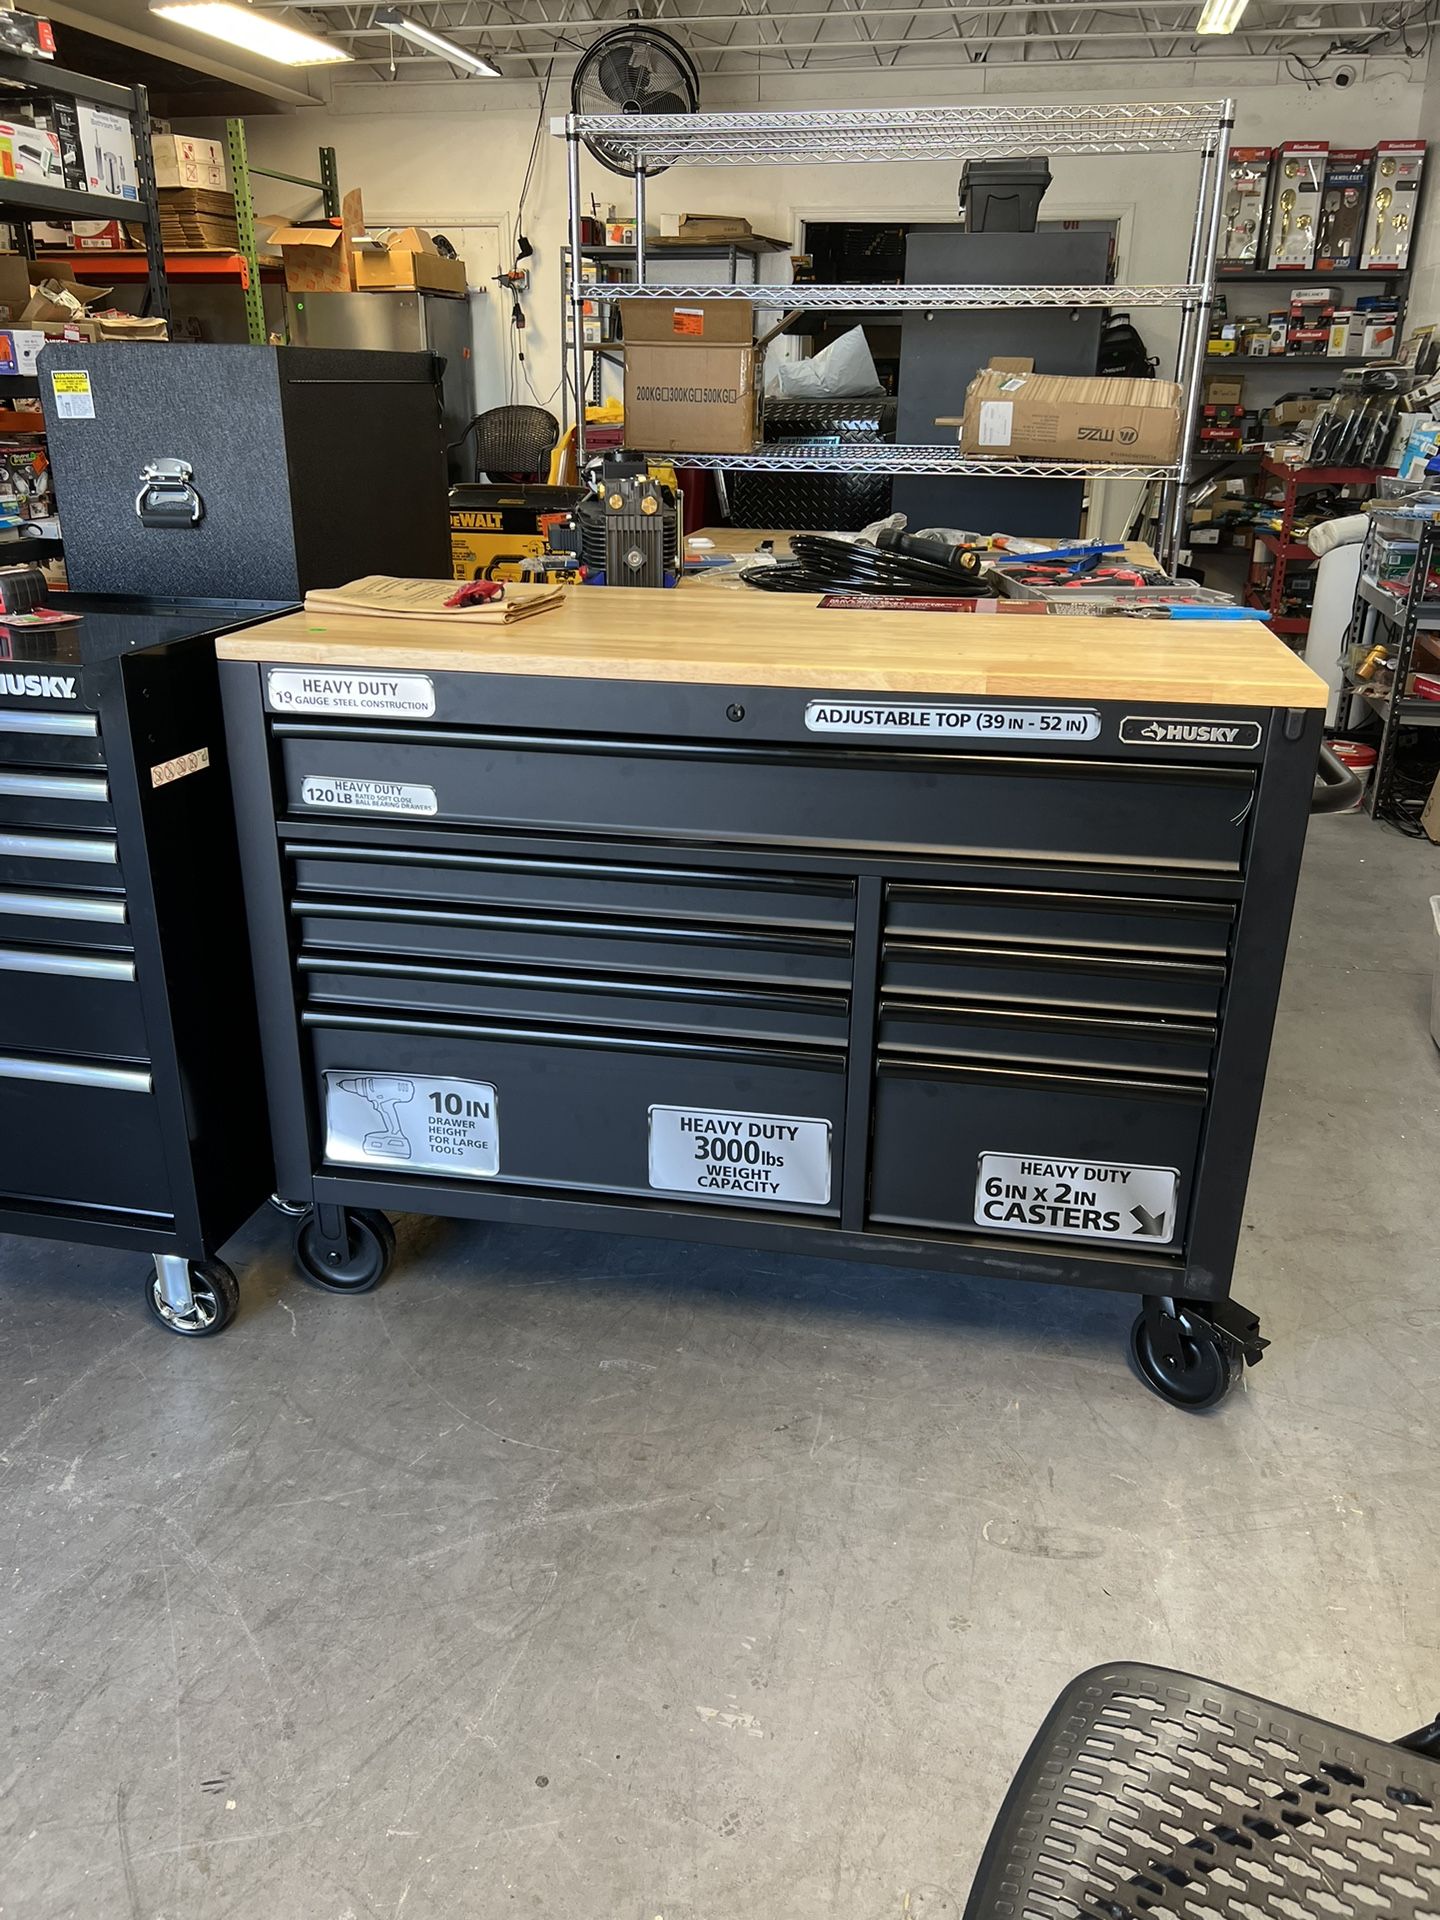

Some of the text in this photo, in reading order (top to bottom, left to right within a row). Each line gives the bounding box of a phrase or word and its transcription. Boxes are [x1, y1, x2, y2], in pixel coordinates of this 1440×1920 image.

[1330, 173, 1364, 181] HANDLESET
[303, 679, 398, 696] HEAVY DUTY
[276, 691, 428, 711] 19 GAUGE STEEL CONSTRUCTION
[815, 709, 930, 727] ADJUSTABLE
[936, 712, 971, 728] TOP
[976, 713, 1005, 731] (39
[1008, 718, 1024, 730] IN
[1040, 716, 1061, 731] 52
[1066, 716, 1087, 734] IN)
[1166, 725, 1239, 742] HUSKY
[335, 781, 403, 796] HEAVY DUTY
[355, 793, 375, 801] RATED
[401, 803, 432, 811] DRAWERS
[428, 1116, 476, 1129] DRAWER
[680, 1117, 799, 1141] HEAVY DUTY
[428, 1125, 468, 1138] HEIGHT
[429, 1135, 489, 1150] FOR LARGE
[430, 1144, 464, 1156] TOOLS
[706, 1164, 772, 1181] WEIGHT
[1020, 1161, 1131, 1184] HEAVY DUTY
[697, 1176, 780, 1194] CAPACITY
[983, 1200, 1120, 1232] CASTERS
